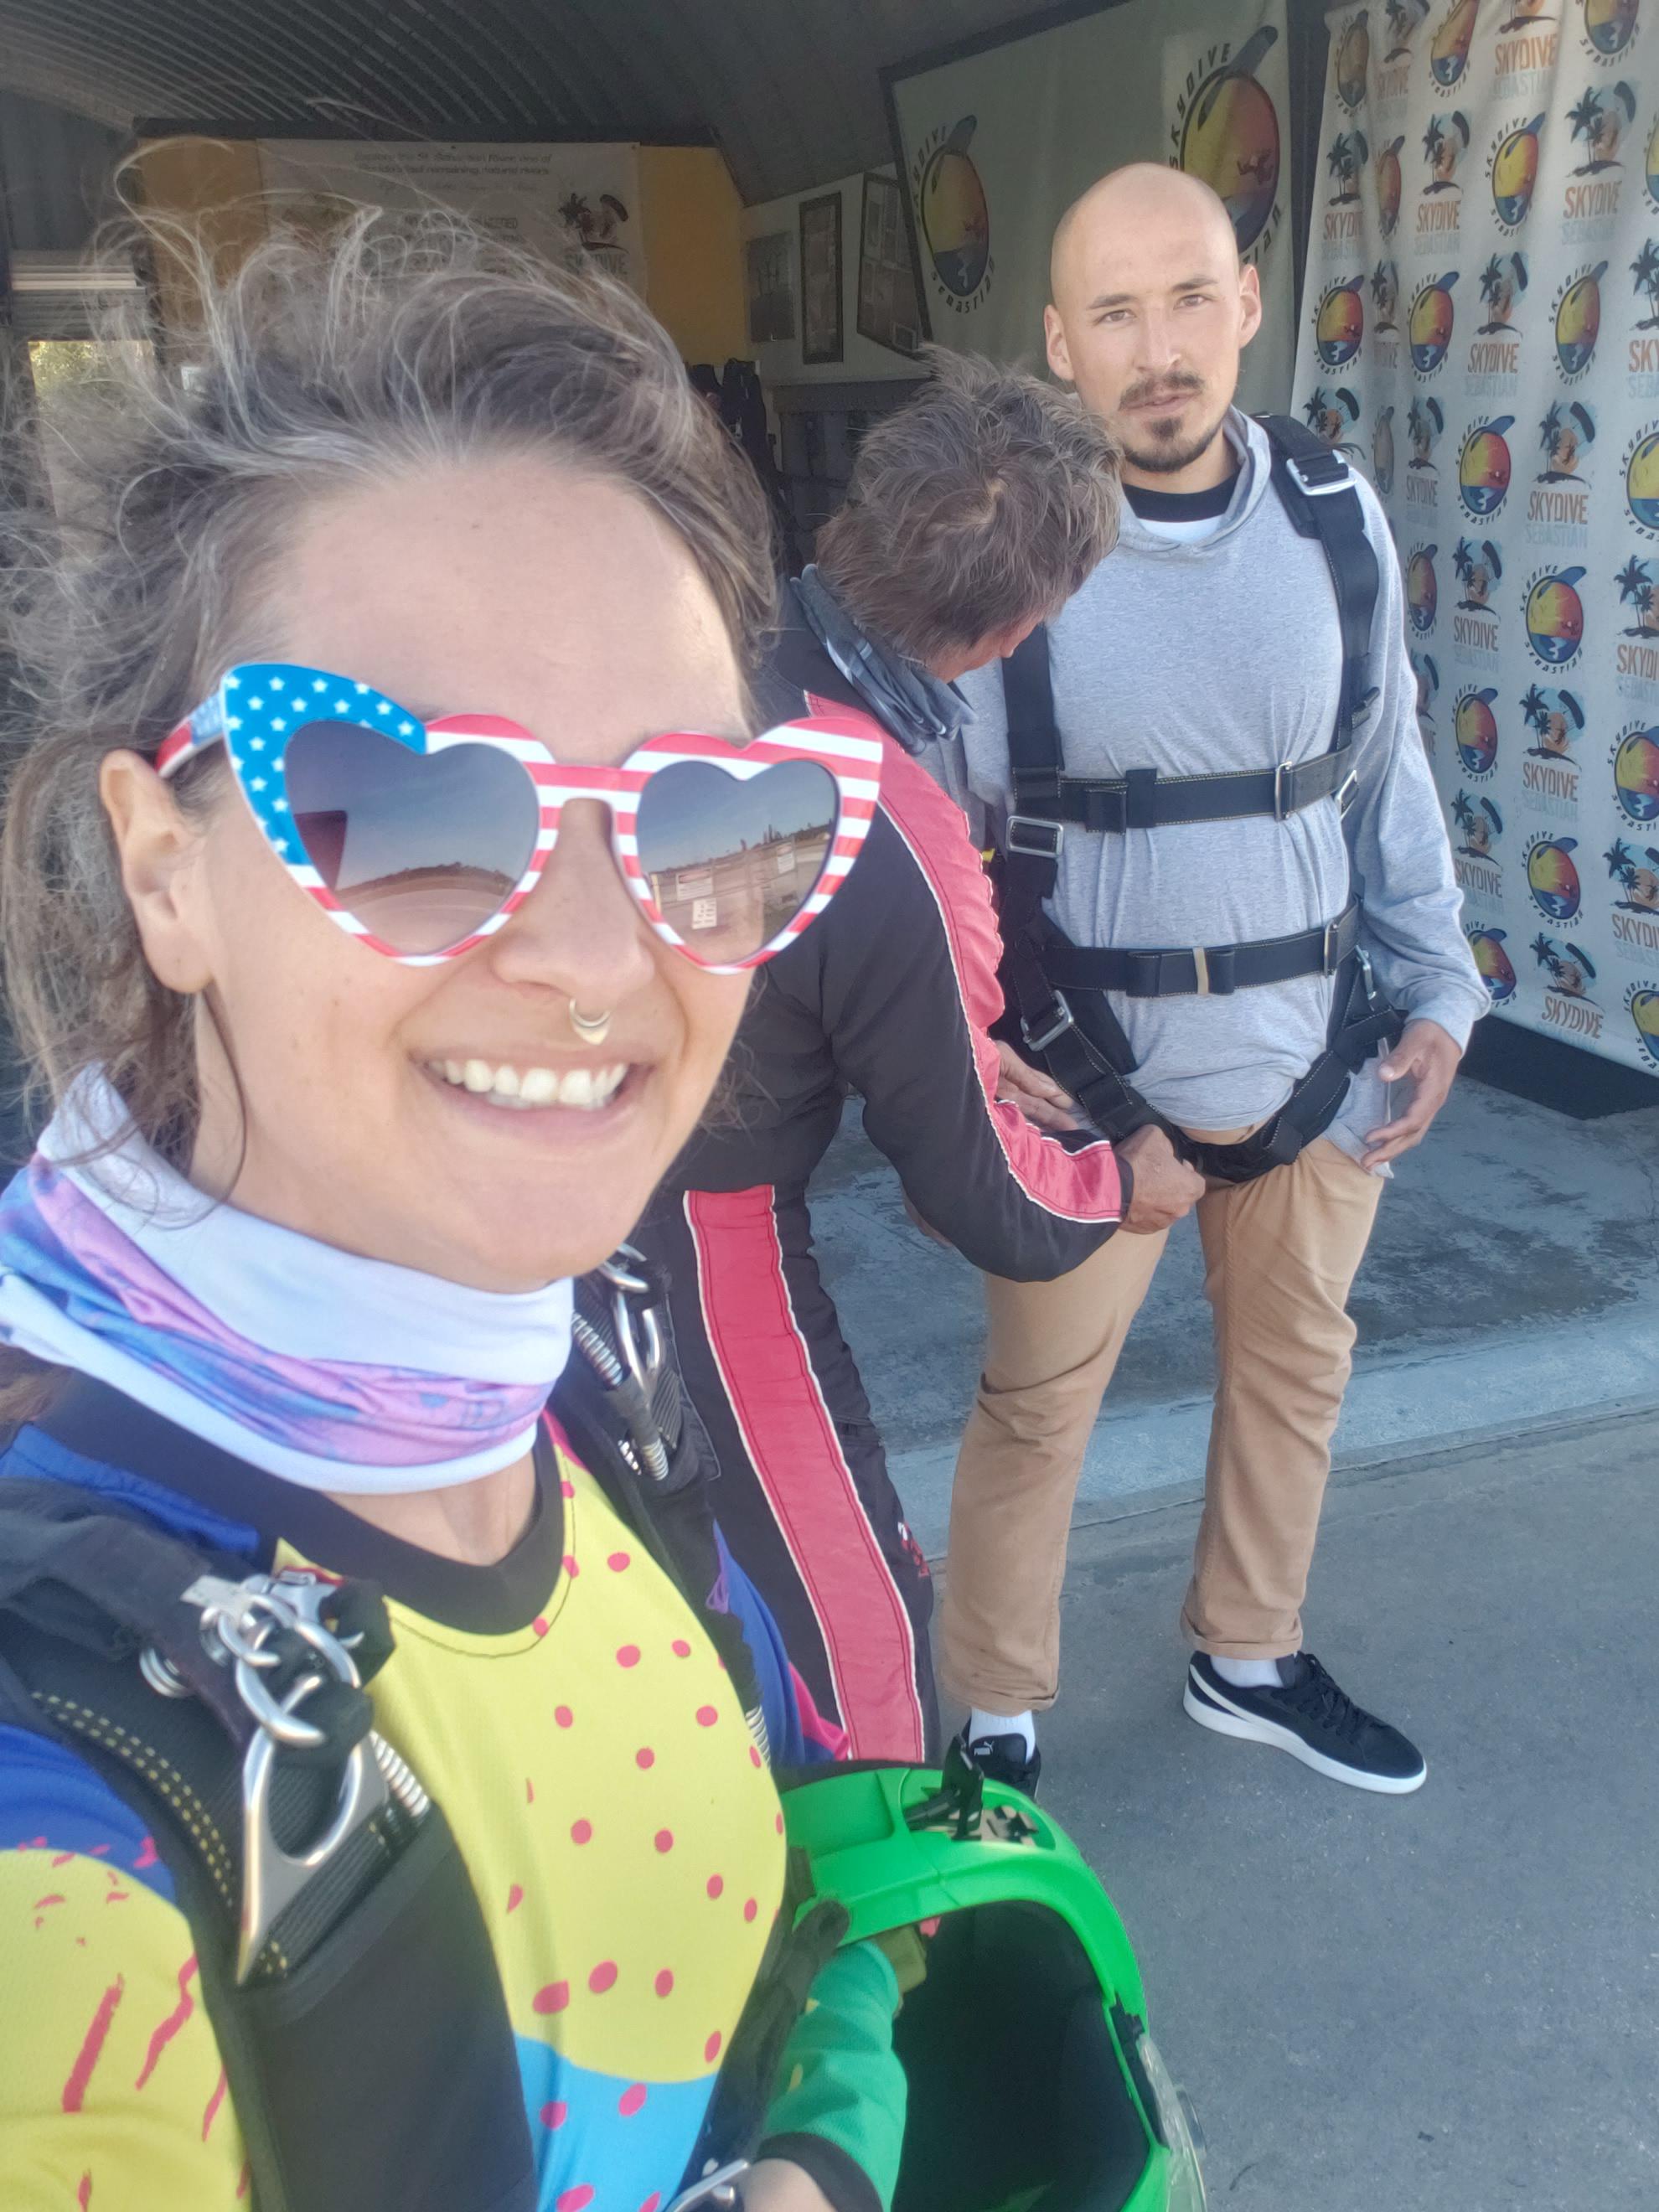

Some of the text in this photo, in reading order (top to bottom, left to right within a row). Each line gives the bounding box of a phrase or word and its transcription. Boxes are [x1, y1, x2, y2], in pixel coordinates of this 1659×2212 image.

[1416, 201, 1461, 233] SKYDIVE
[1563, 181, 1623, 219] SKYDIVE
[1467, 343, 1520, 374] SKYDIVE
[1527, 490, 1589, 525] SKYDIVE
[1454, 615, 1500, 652] SKYDIVE
[1615, 643, 1658, 681] SKYDI
[1522, 761, 1579, 803] SKYDIVE
[1454, 858, 1503, 899] SKYDIVE
[1541, 995, 1604, 1039] SKYDIVE
